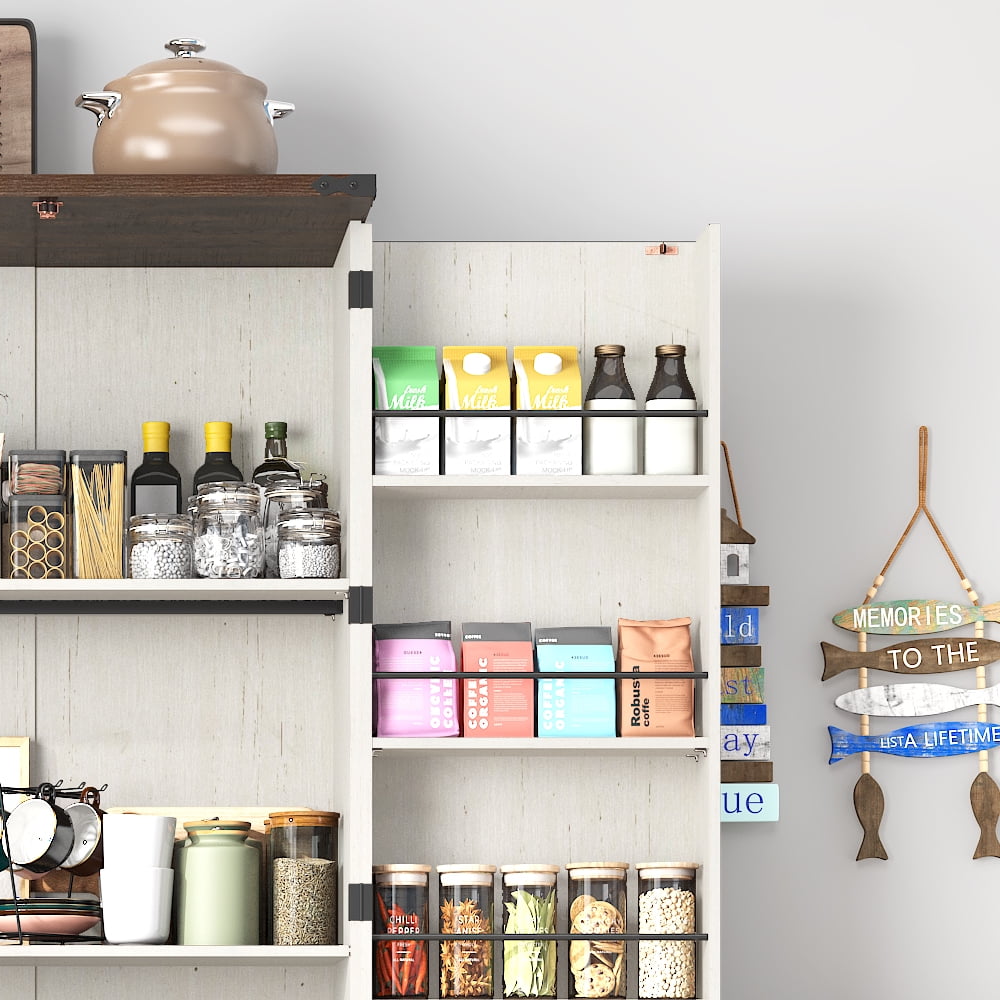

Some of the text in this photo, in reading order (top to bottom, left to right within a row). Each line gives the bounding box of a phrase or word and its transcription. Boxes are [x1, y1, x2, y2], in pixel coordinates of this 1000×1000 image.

[390, 394, 427, 409] Milk
[462, 394, 498, 409] Milk
[533, 394, 569, 409] Milk
[721, 615, 753, 638] ld
[853, 605, 962, 628] MEMORIES
[887, 641, 980, 670] TO THE
[630, 665, 641, 727] Robusa
[721, 674, 753, 696] st
[468, 679, 477, 729] COFFE
[543, 679, 553, 730] COFFE
[641, 698, 650, 727] coffe
[723, 732, 760, 757] ay
[924, 726, 1000, 748] LIFETIME
[722, 791, 764, 814] ue
[389, 915, 418, 924] CHILLI
[458, 915, 480, 924] STAR
